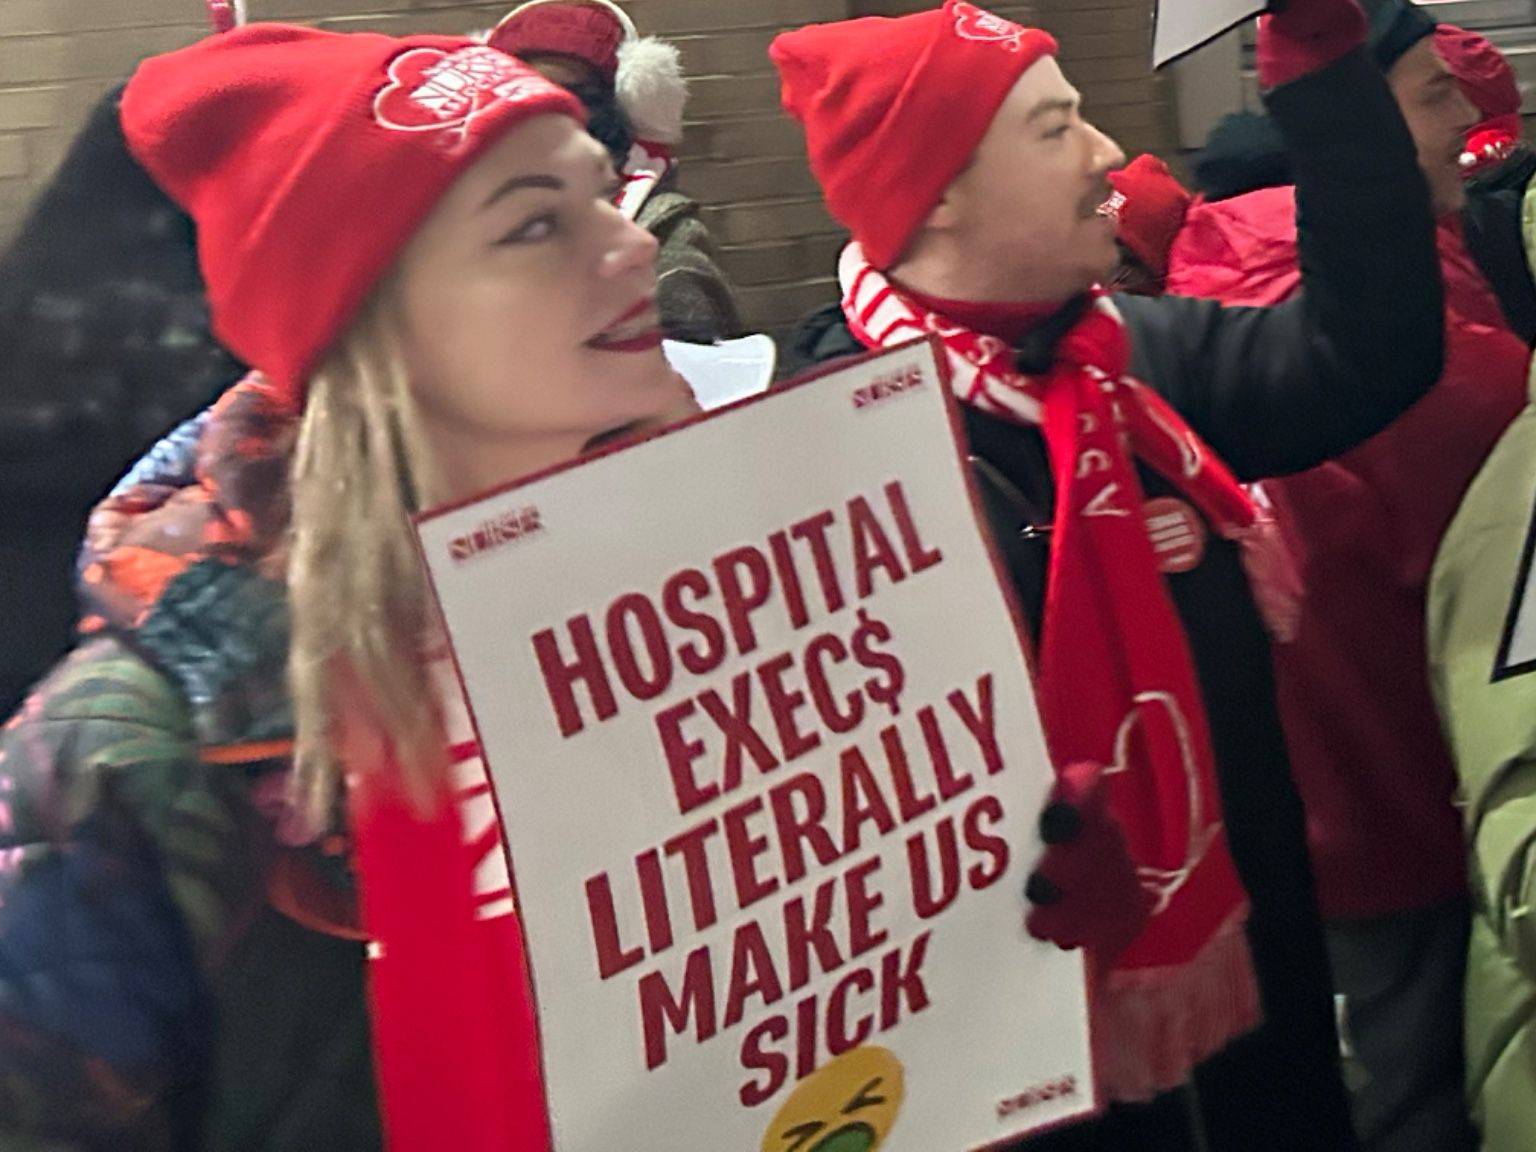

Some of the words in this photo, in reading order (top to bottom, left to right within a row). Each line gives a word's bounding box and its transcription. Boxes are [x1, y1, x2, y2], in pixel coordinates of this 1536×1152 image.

[531, 481, 942, 738] HOSPITAL
[655, 607, 907, 815] EXEC$
[584, 674, 1005, 980] LITERALLY
[638, 856, 888, 1072] MAKE
[906, 795, 1010, 918] US
[738, 930, 934, 1107] SICK
